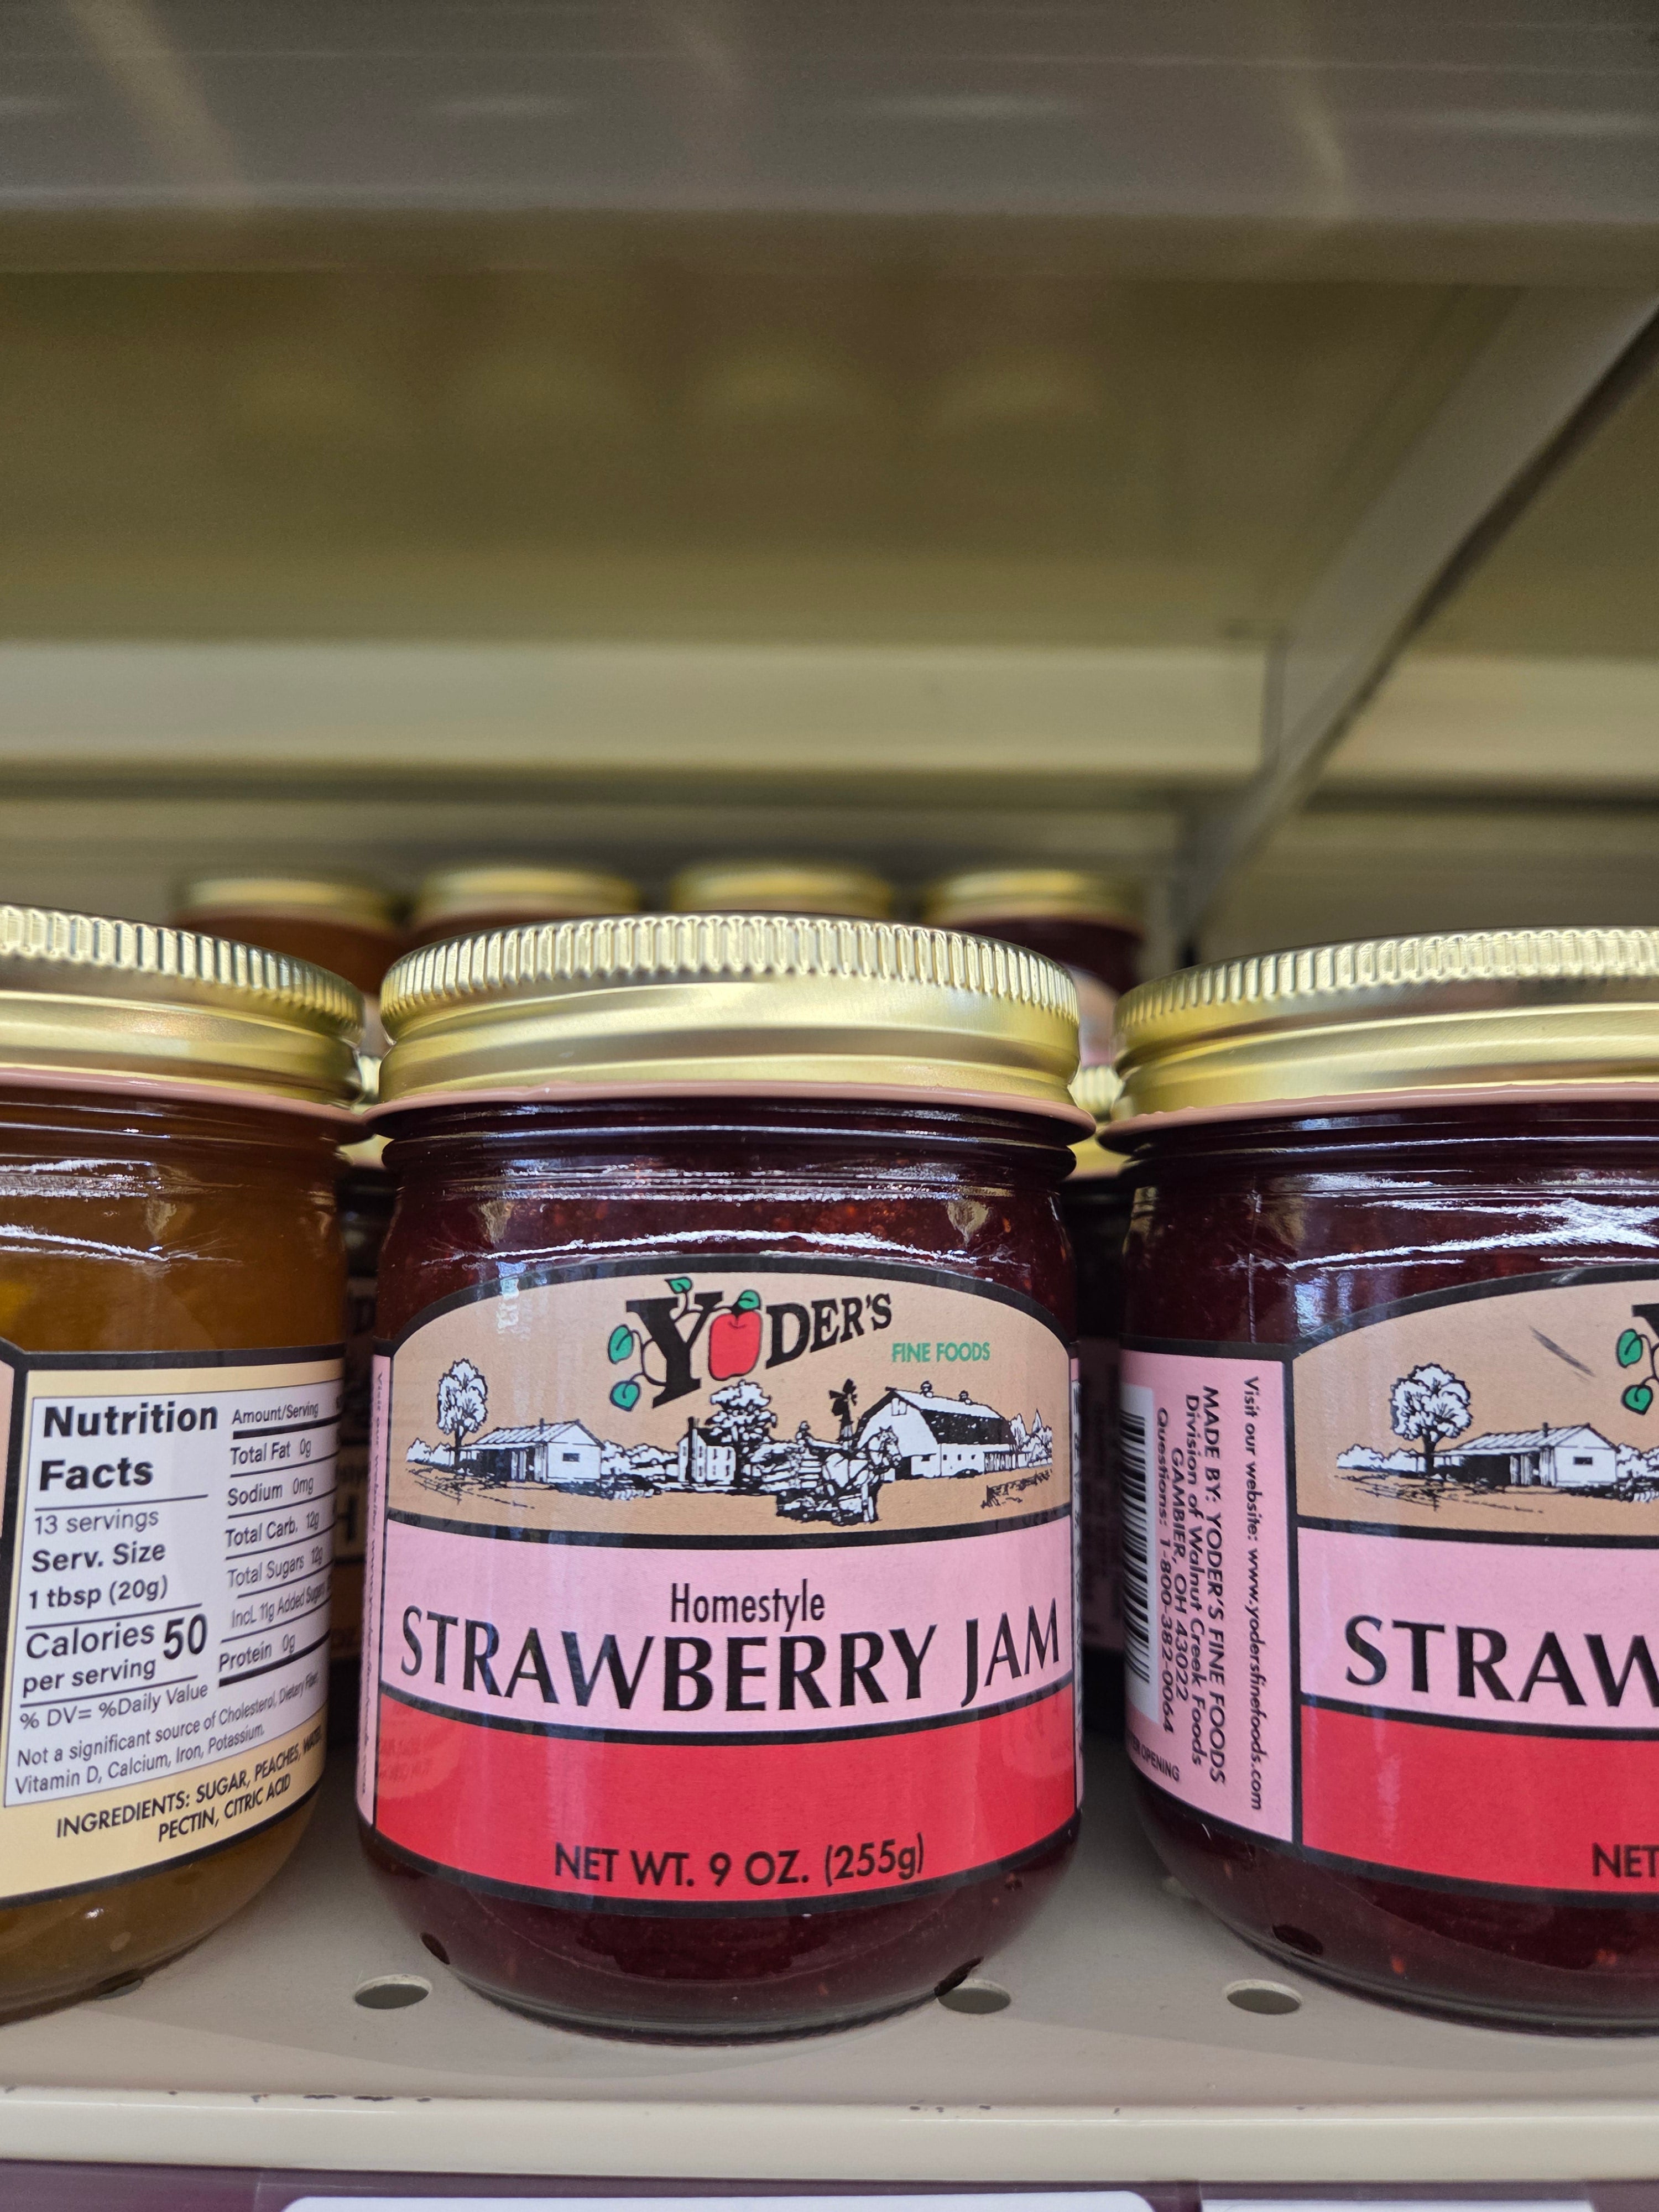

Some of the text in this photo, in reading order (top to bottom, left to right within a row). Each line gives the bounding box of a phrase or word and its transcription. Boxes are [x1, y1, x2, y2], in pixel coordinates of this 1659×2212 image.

[626, 1288, 893, 1408] YODER'S
[891, 1341, 991, 1363] FINE FOODS
[44, 1401, 218, 1438] Nutrition
[232, 1401, 319, 1425] Amount/Serving
[230, 1438, 311, 1465] Total Fat 0g
[39, 1457, 154, 1491] Facts
[227, 1477, 314, 1506] Sodium 0mg
[35, 1508, 159, 1535] 13 servings
[226, 1511, 320, 1547] Total Carb. 12g
[32, 1541, 166, 1572] Serv. Size
[227, 1546, 323, 1588] Total Sugars 12g
[1157, 1407, 1174, 1733] Questions: 1-800-382-0064
[1171, 1447, 1188, 1701] GAMBIER, OH 43022
[29, 1574, 168, 1609] 1 tbsp (20g)
[277, 1588, 305, 1616] Added
[1186, 1394, 1207, 1766] Division of Walnut Creek Foods
[1203, 1385, 1225, 1785] MADE BY: YODER'S FINE FOODS
[1244, 1376, 1266, 1811] Visit our website: www.yodersfinefoods.com
[669, 1578, 826, 1632] Homestyle
[27, 1613, 208, 1660] Calories 50
[218, 1634, 296, 1673] Protein 0g
[400, 1597, 1060, 1712] STRAWBERRY JAM
[22, 1658, 156, 1698] per serving
[1344, 1614, 1659, 1708] STRAW
[18, 1747, 48, 1767] Not
[55, 1748, 62, 1762] a
[69, 1729, 150, 1761] significant
[155, 1720, 200, 1743] source
[204, 1710, 216, 1729] of
[219, 1691, 277, 1725] Cholesterol,
[20, 1684, 208, 1730] % DV= %Daily Value
[15, 1723, 264, 1794] Vitamin D, Calcium, Iron, Potassium.
[1141, 1744, 1180, 1782] OPENING
[56, 1790, 190, 1838] INGREDIENTS:
[196, 1769, 251, 1803] SUGAR,
[254, 1743, 301, 1782] PEACHES,
[158, 1772, 291, 1842] PECTIN, CITRIC ACID
[555, 1832, 924, 1887] NET WT. 9 OZ. (255g)
[1592, 1843, 1659, 1878] NET
